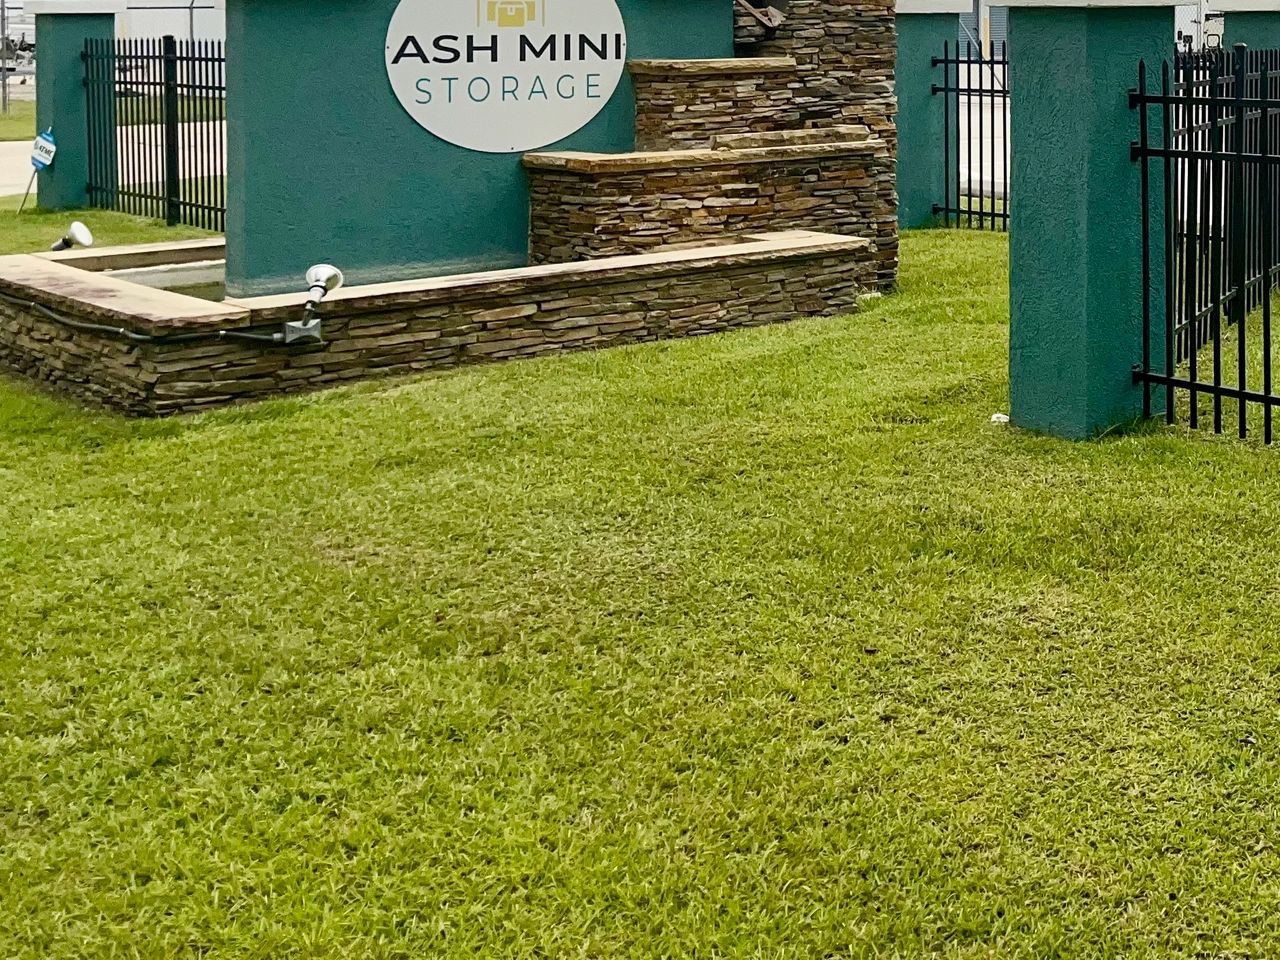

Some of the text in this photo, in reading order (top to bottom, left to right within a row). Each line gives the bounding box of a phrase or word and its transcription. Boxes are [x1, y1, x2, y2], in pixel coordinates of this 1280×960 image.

[391, 33, 622, 64] ASH MINI
[415, 73, 601, 104] STORAGE
